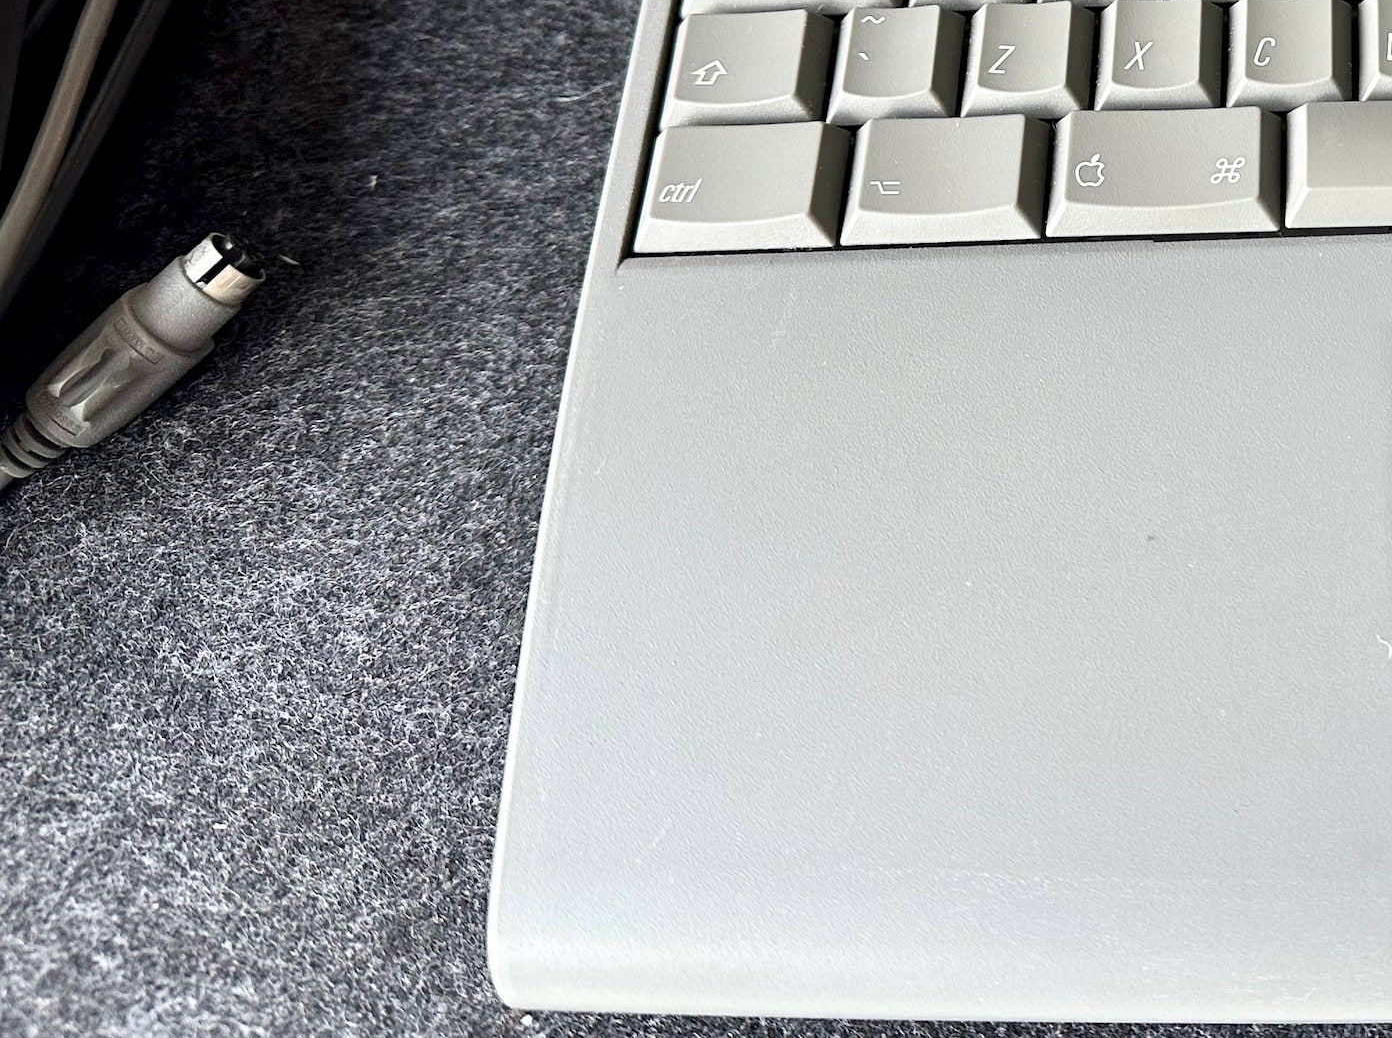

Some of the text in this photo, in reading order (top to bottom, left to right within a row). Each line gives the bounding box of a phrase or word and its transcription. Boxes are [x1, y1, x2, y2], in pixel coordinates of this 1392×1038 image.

[988, 45, 1015, 73] Z
[1124, 42, 1153, 70] X
[1254, 37, 1275, 66] C
[659, 179, 702, 202] ctrl
